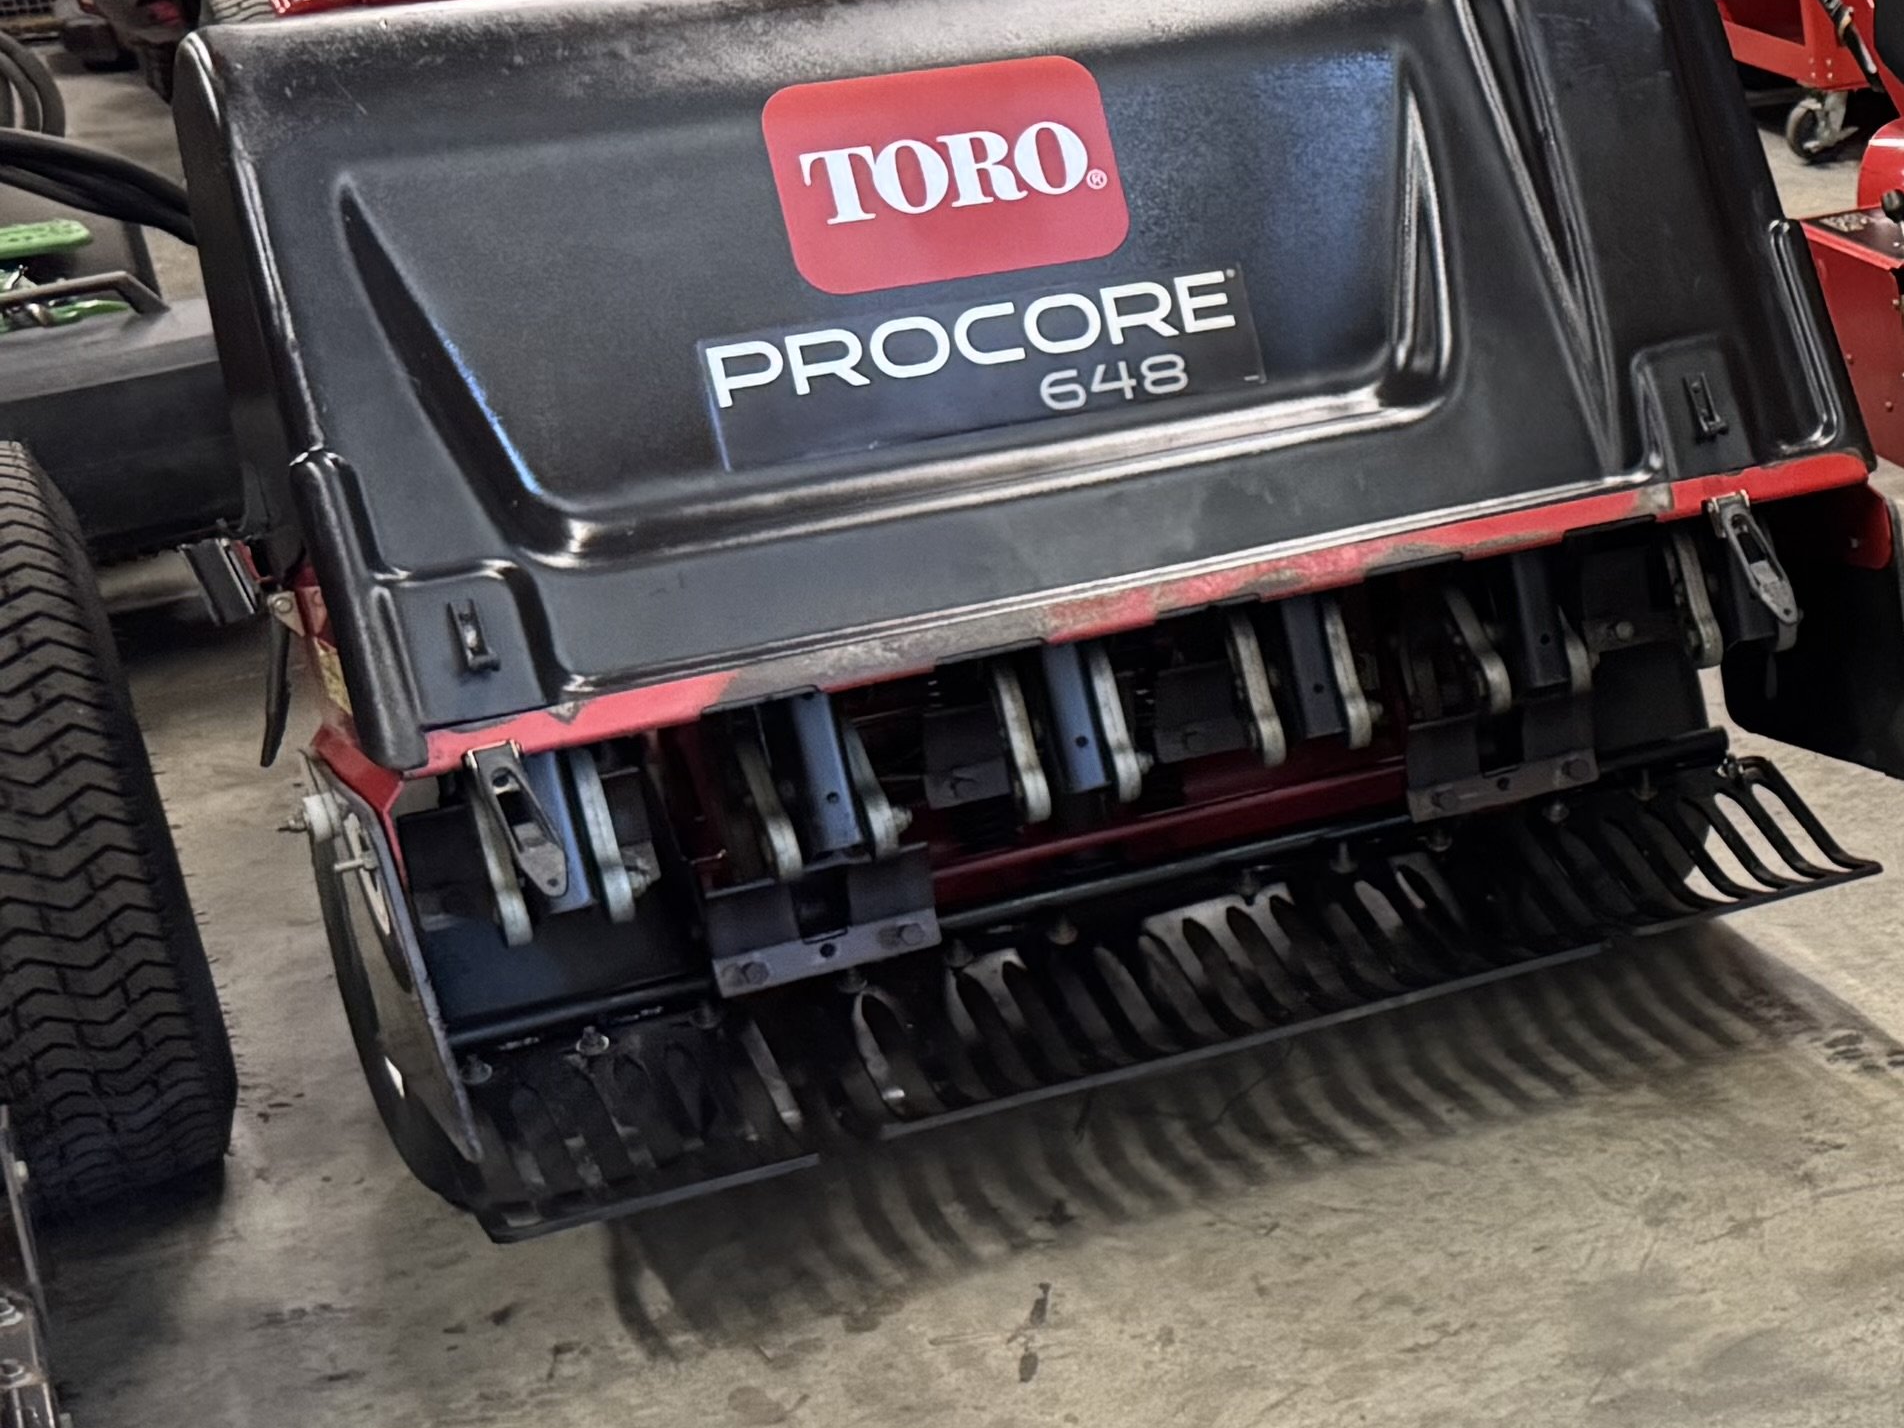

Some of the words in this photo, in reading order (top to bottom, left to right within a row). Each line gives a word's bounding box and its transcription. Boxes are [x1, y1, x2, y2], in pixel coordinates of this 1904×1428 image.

[799, 120, 1090, 226] TORO
[704, 268, 1237, 408] PROCORE
[1039, 353, 1188, 411] 648
